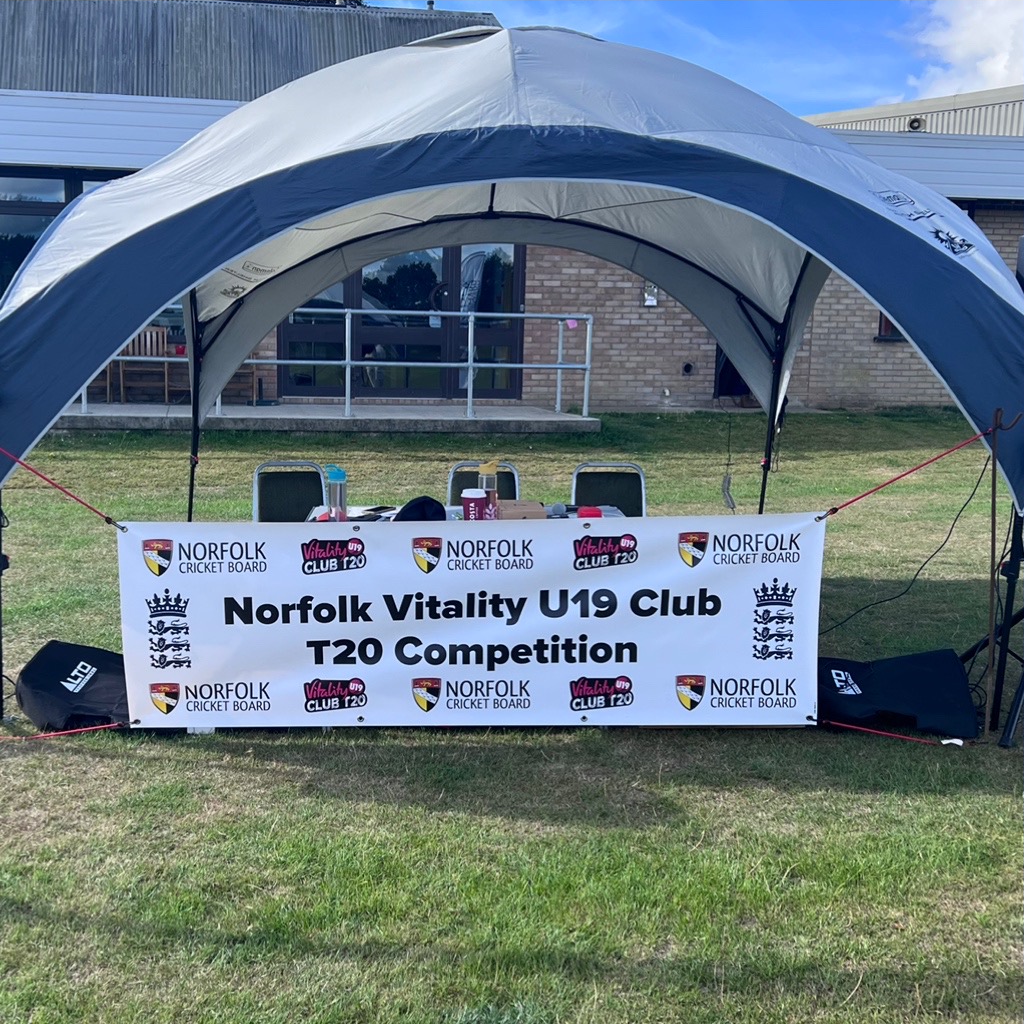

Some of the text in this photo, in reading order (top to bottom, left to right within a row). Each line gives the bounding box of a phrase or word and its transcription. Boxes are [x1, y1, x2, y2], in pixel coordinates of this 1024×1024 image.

[178, 541, 267, 561] NORFOLK
[303, 540, 347, 560] Vitality
[348, 542, 363, 552] U19
[447, 539, 534, 559] NORFOLK
[575, 537, 619, 556] Vitality
[620, 538, 635, 548] U19
[713, 532, 801, 553] NORFOLK
[178, 560, 267, 574] CRICKET BOARD
[304, 555, 365, 574] CLUB T20
[447, 558, 534, 571] CRICKET BOARD
[575, 551, 637, 569] CLUB T20
[713, 551, 800, 565] CRICKET BOARD
[223, 587, 722, 626] Norfolk Vitality U19 Club
[306, 633, 638, 672] T20 Competition
[184, 681, 271, 701] NORFOLK
[306, 680, 348, 699] Vitality
[349, 683, 363, 692] U19
[446, 679, 531, 698] NORFOLK
[572, 679, 615, 697] Vitality
[616, 680, 630, 690] U19
[710, 678, 797, 697] NORFOLK
[186, 699, 271, 712] CRICKET BOARD
[306, 694, 366, 711] CLUB T20
[446, 697, 531, 710] CRICKET BOARD
[572, 692, 633, 710] CLUB T20
[710, 696, 797, 709] CRICKET BOARD
